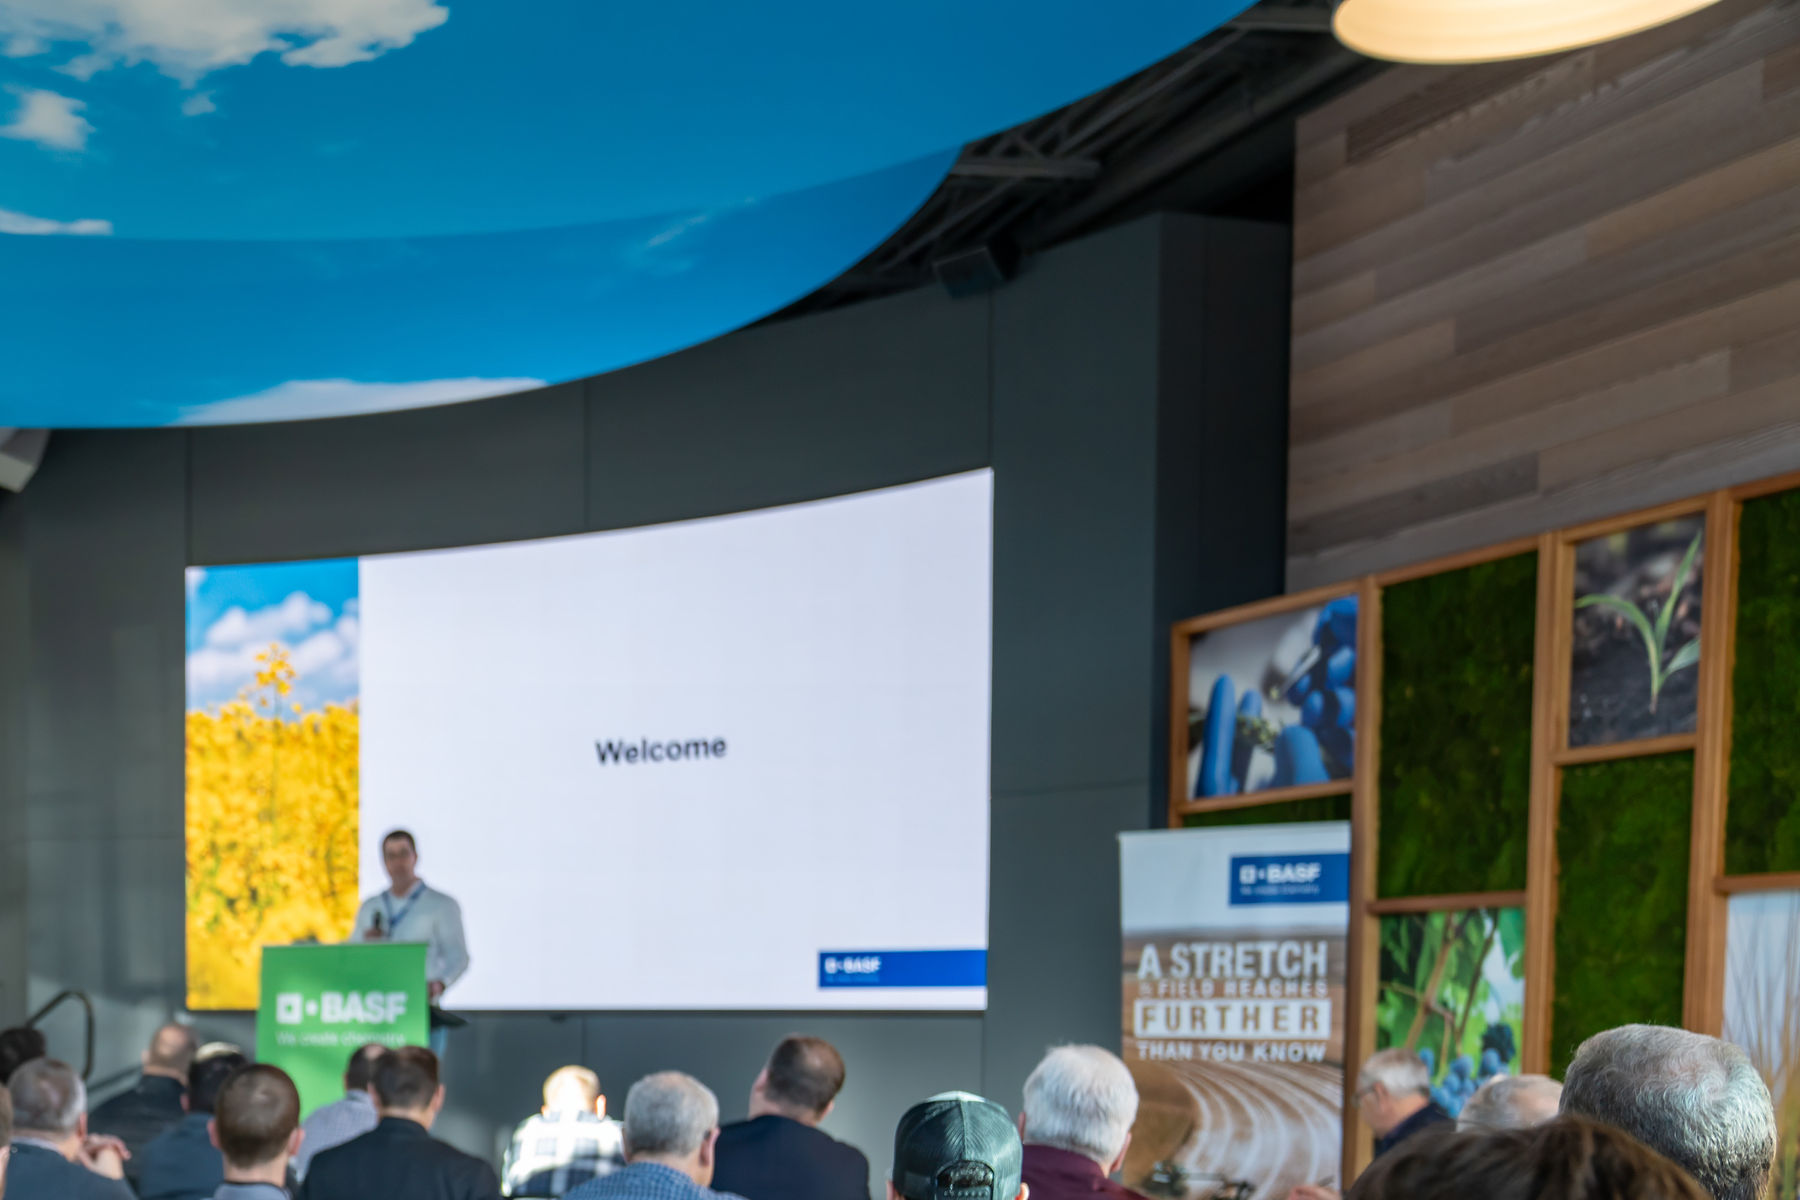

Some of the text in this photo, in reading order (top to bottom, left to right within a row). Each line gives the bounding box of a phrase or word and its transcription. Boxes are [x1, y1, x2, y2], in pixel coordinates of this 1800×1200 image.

[595, 737, 727, 765] Welcome
[1266, 862, 1321, 884] BASF
[1137, 940, 1329, 979] A STRETCH
[1158, 979, 1215, 998] FIELD
[1224, 978, 1329, 998] REACHES
[320, 991, 409, 1024] BASF
[1141, 1004, 1319, 1031] FURTHER
[1137, 1041, 1326, 1063] THAN YOU KNOW
